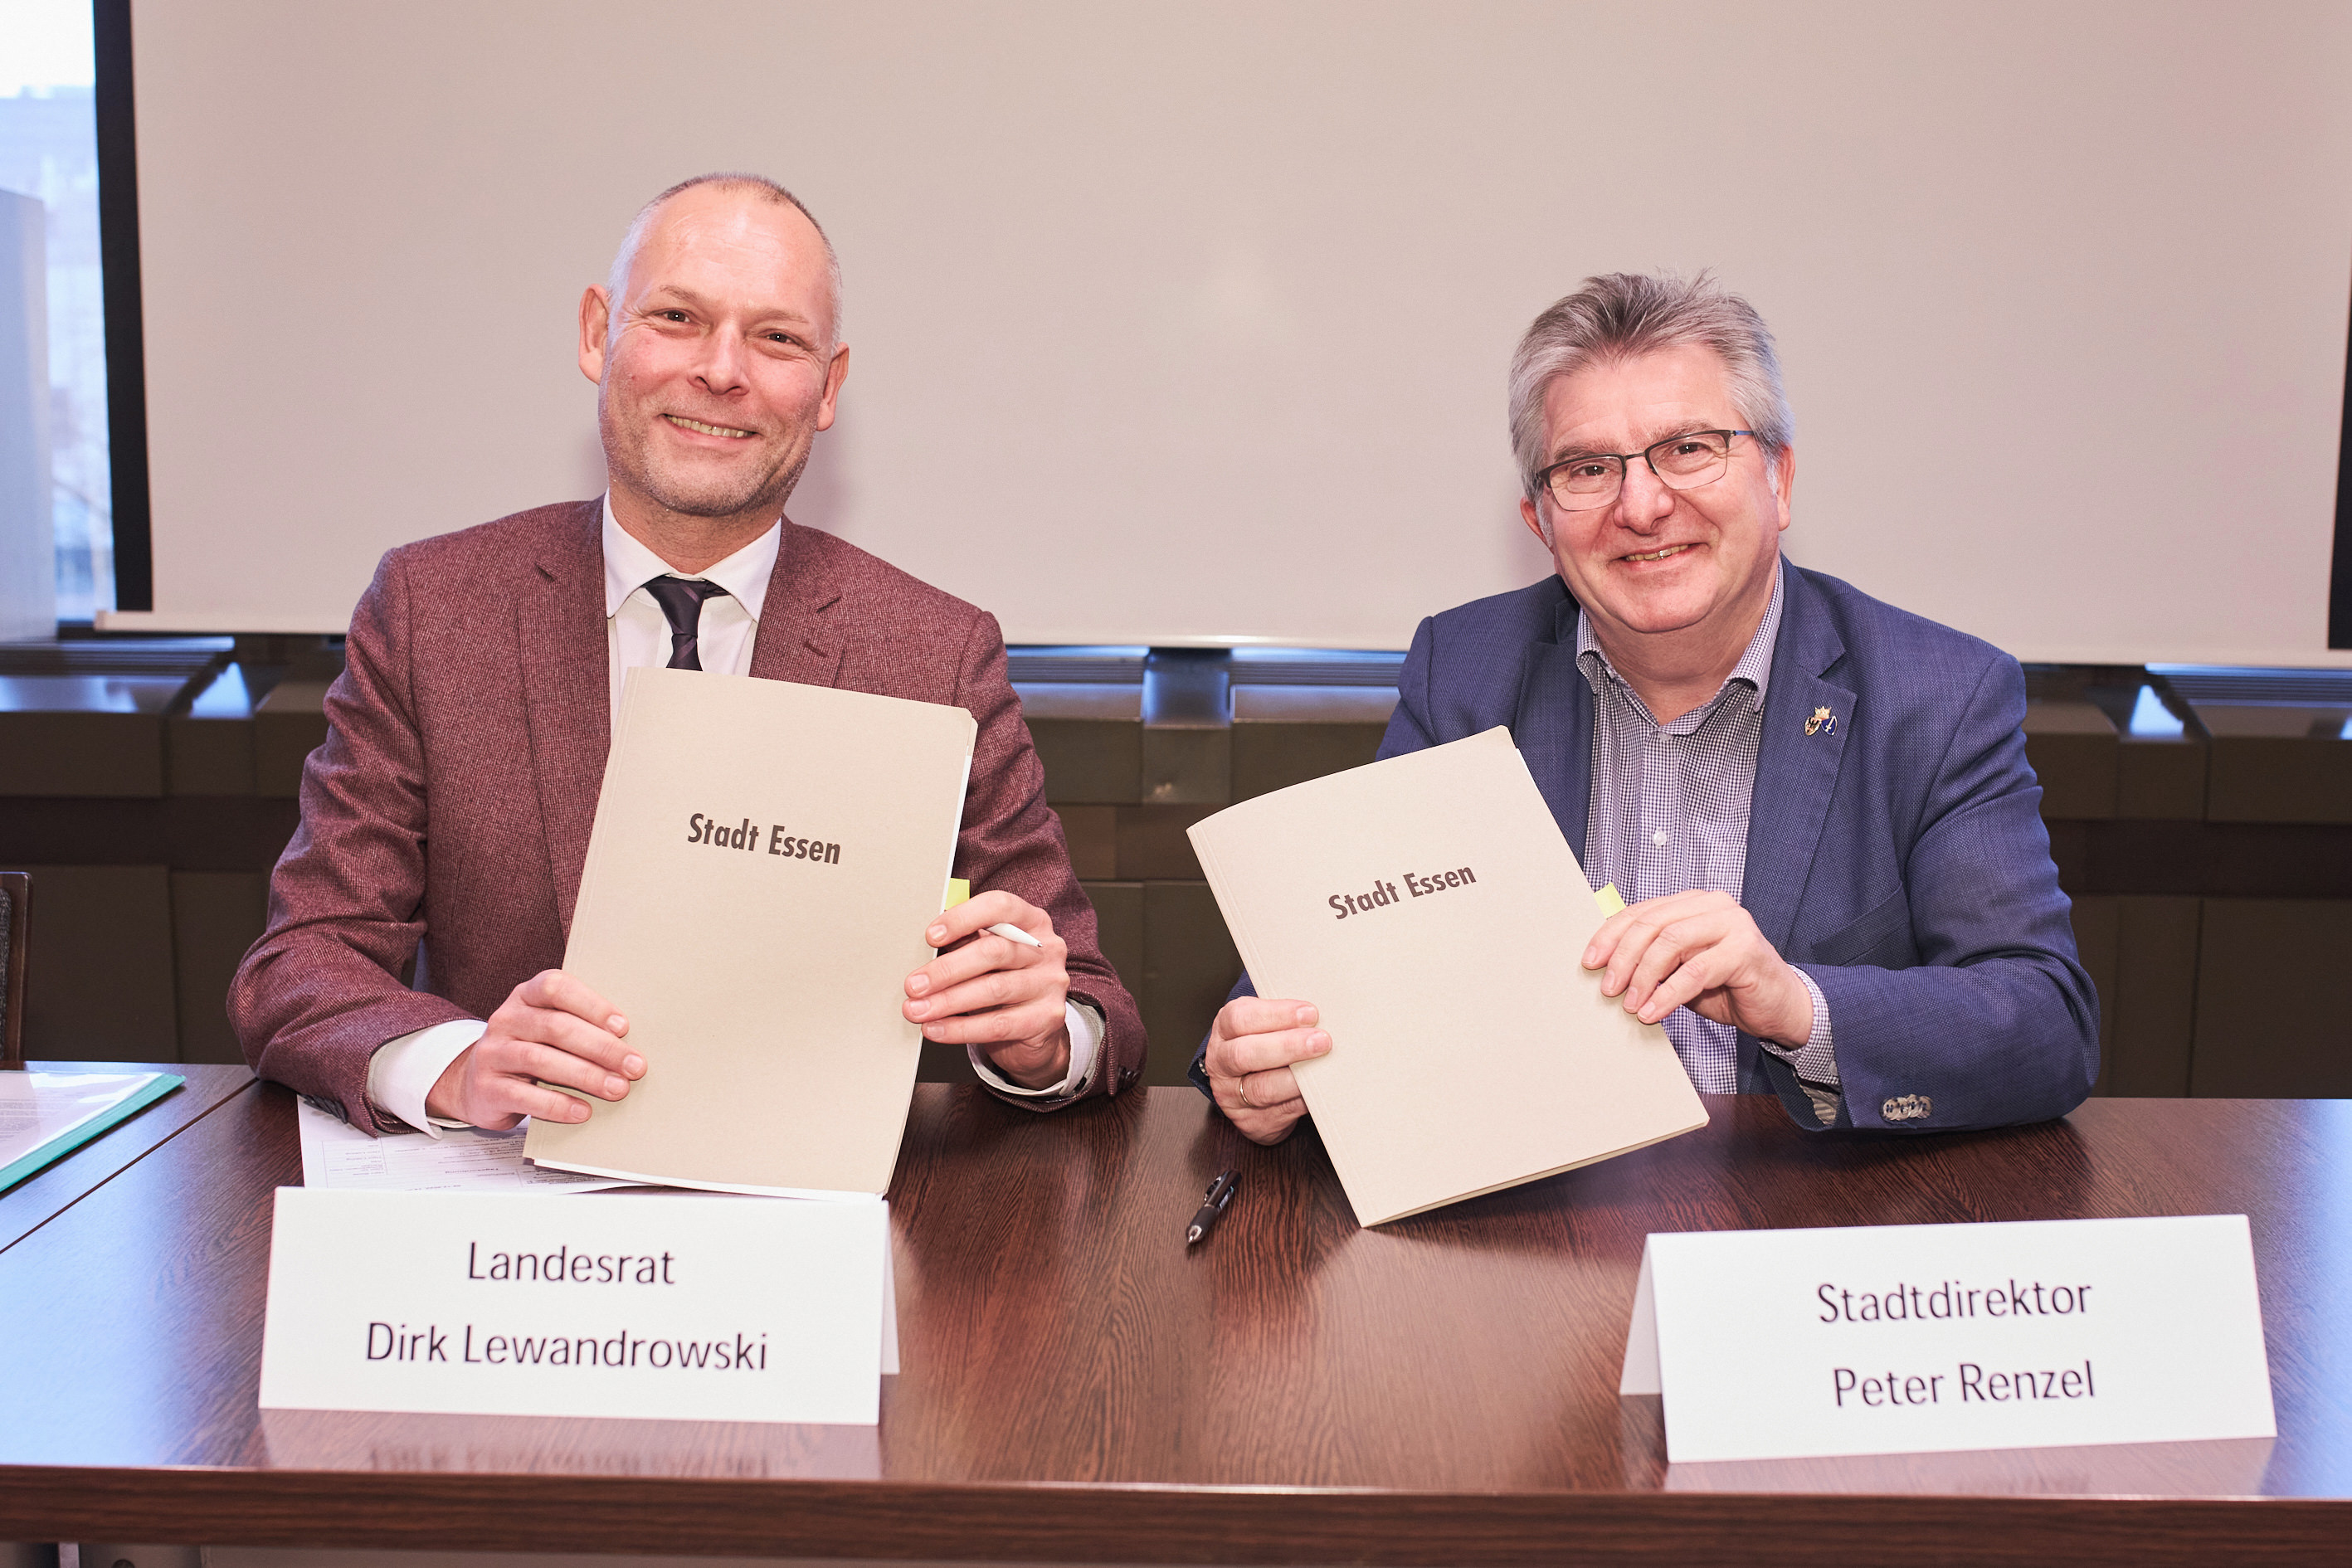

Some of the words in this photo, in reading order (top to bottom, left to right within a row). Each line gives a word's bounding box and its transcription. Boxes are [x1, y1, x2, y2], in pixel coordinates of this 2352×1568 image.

[687, 812, 760, 852] Stadt
[768, 824, 841, 865] Essen
[1328, 879, 1400, 920] Stadt
[1402, 865, 1477, 898] Essen
[469, 1241, 674, 1285] Landesrat
[1818, 1278, 2091, 1323] Stadtdirektor
[367, 1322, 447, 1362] Dirk
[464, 1324, 767, 1371] Lewandrowski
[1833, 1368, 1944, 1407] Peter
[1959, 1360, 2094, 1402] Renzel
